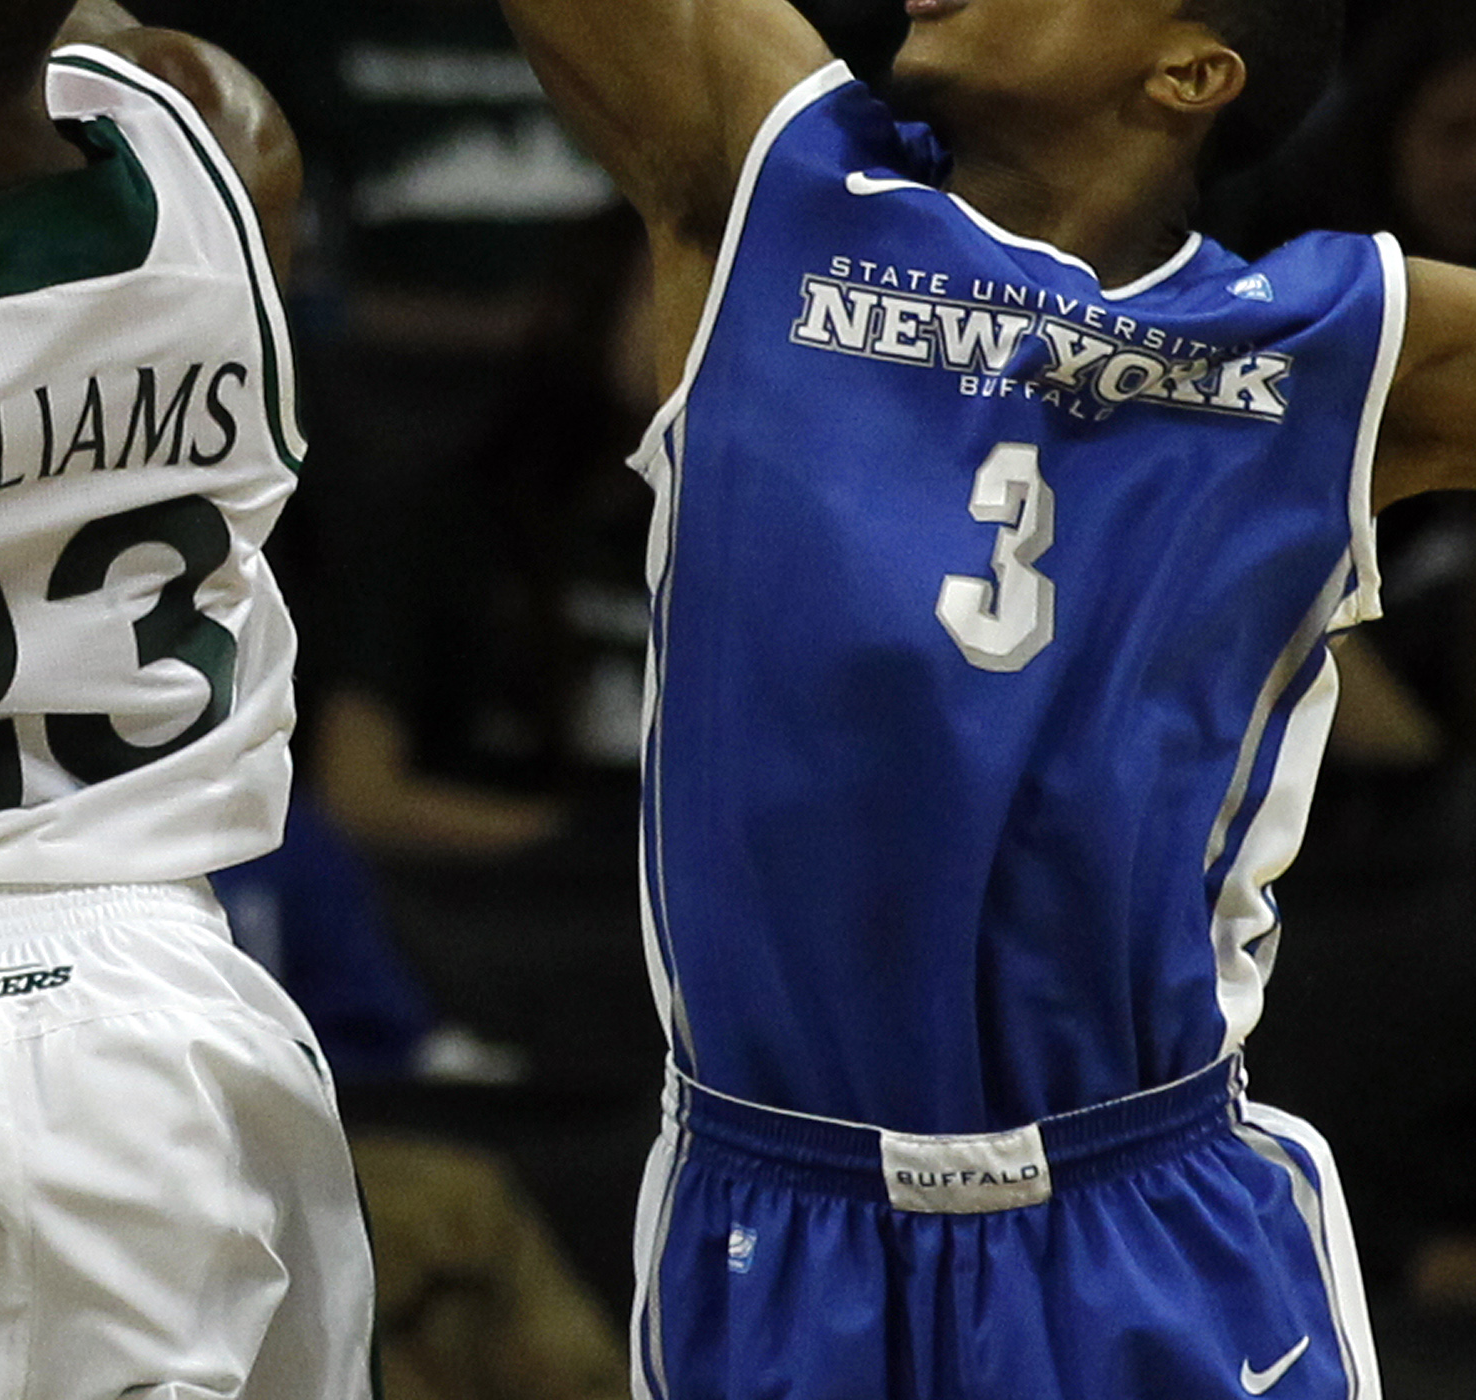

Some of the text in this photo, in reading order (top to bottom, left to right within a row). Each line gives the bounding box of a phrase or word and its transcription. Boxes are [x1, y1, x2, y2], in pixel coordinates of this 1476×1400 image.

[829, 255, 949, 294] STATE
[789, 273, 1293, 425] NEW YORK
[958, 374, 1115, 422] BUFFALO
[934, 441, 1056, 673] 3
[896, 1164, 1039, 1188] BUFFALO
